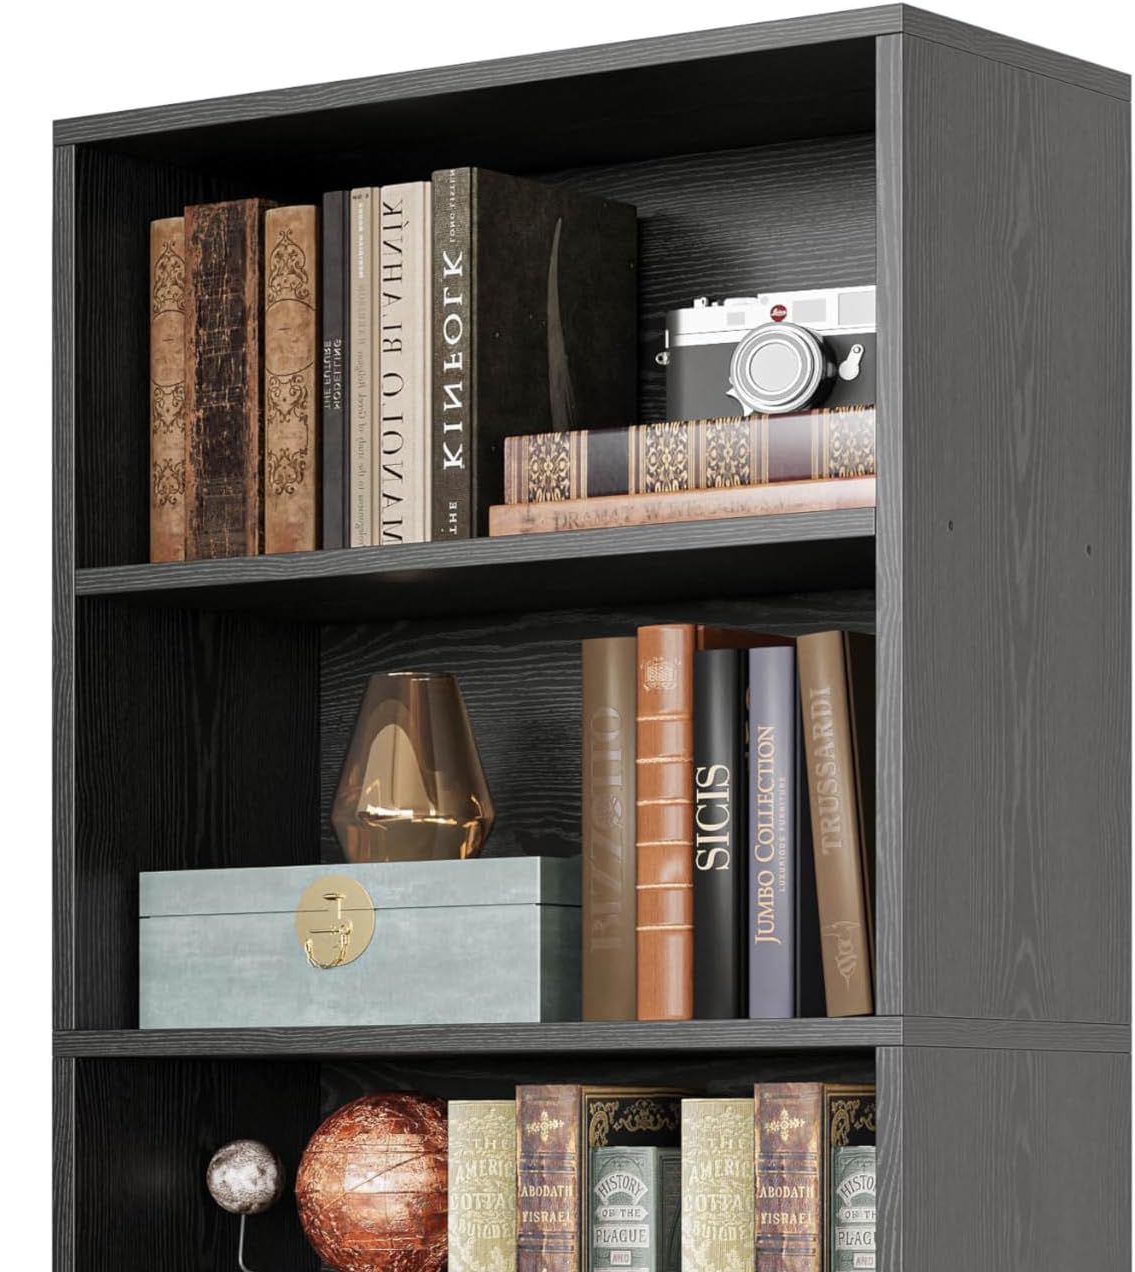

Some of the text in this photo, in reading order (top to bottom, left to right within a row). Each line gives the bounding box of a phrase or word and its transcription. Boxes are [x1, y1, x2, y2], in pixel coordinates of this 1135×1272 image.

[810, 686, 843, 855] TRUSSARDI
[695, 764, 730, 871] SICIS
[754, 725, 782, 944] JUMBO COLLECTION
[598, 1174, 644, 1197] HISTORY
[840, 1175, 876, 1198] HISTO
[620, 1209, 641, 1217] THE
[865, 1210, 876, 1219] TH
[596, 1229, 646, 1243] PLAGUE
[612, 1253, 630, 1262] AND
